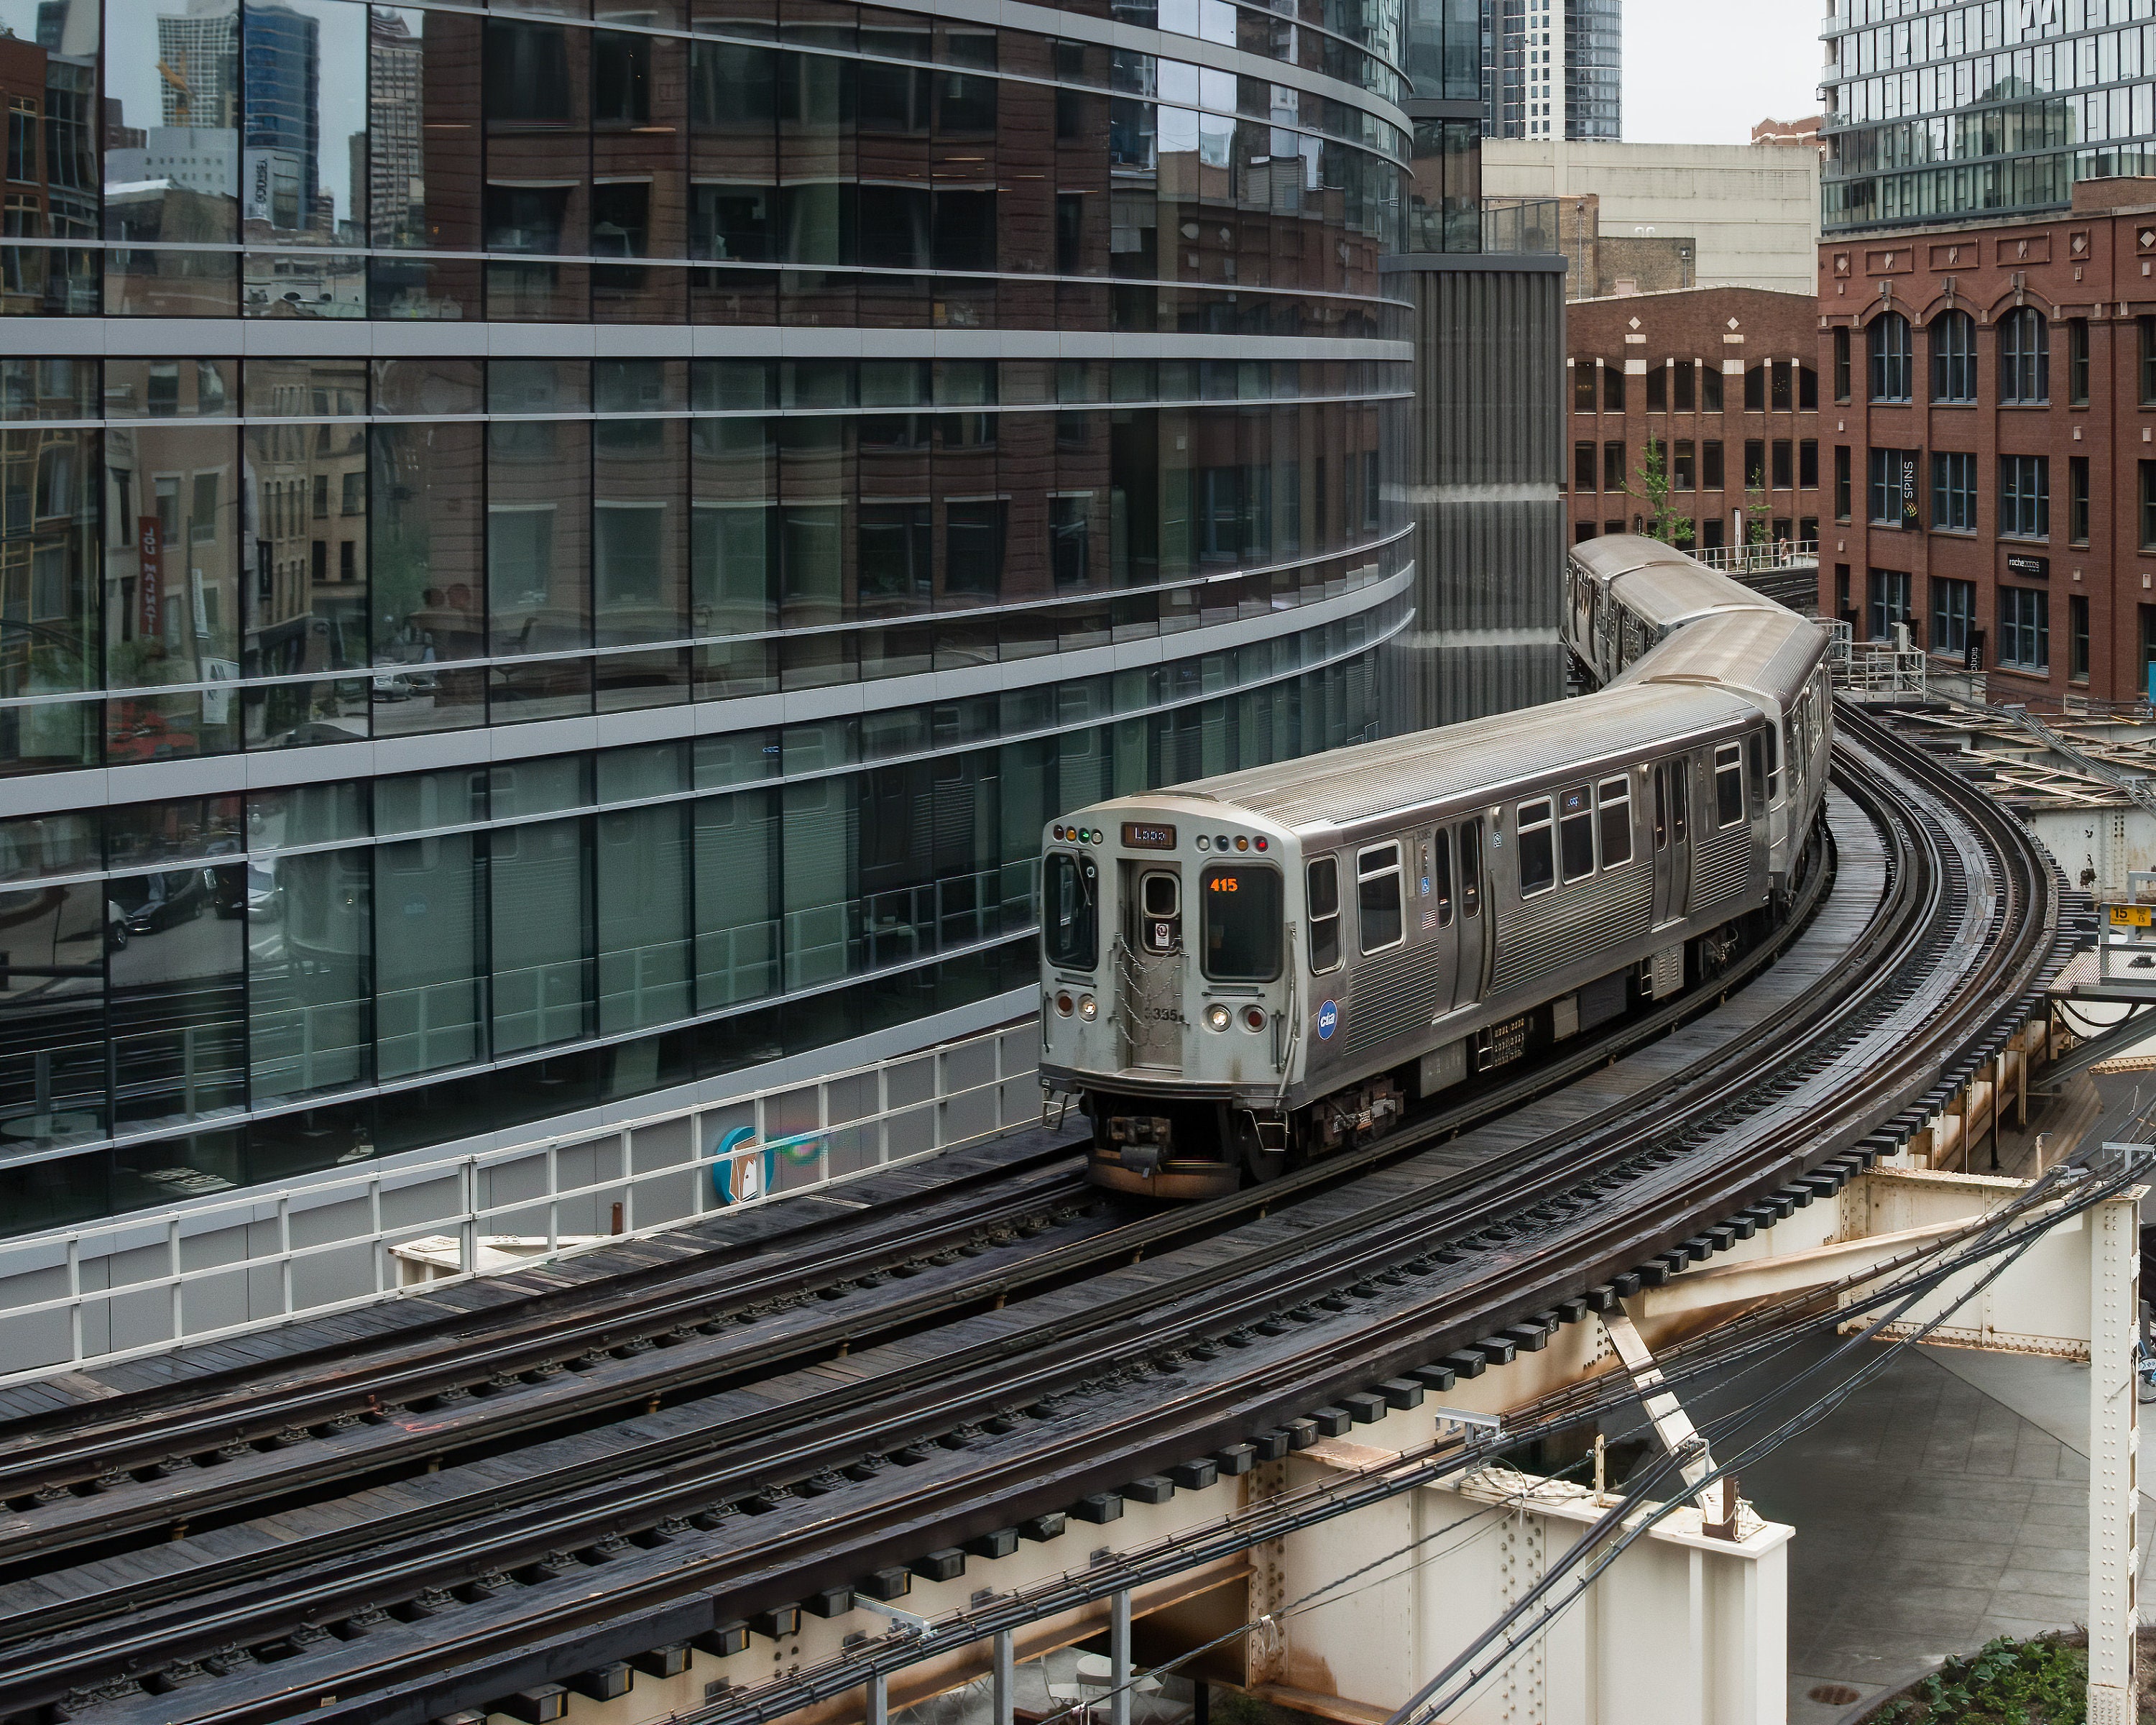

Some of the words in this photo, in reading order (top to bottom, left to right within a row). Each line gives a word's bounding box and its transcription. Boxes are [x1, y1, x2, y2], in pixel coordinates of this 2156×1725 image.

[1904, 461, 1913, 499] SPINS
[1210, 878, 1238, 892] 415
[2114, 907, 2127, 919] 15
[1320, 1012, 1335, 1028] cta
